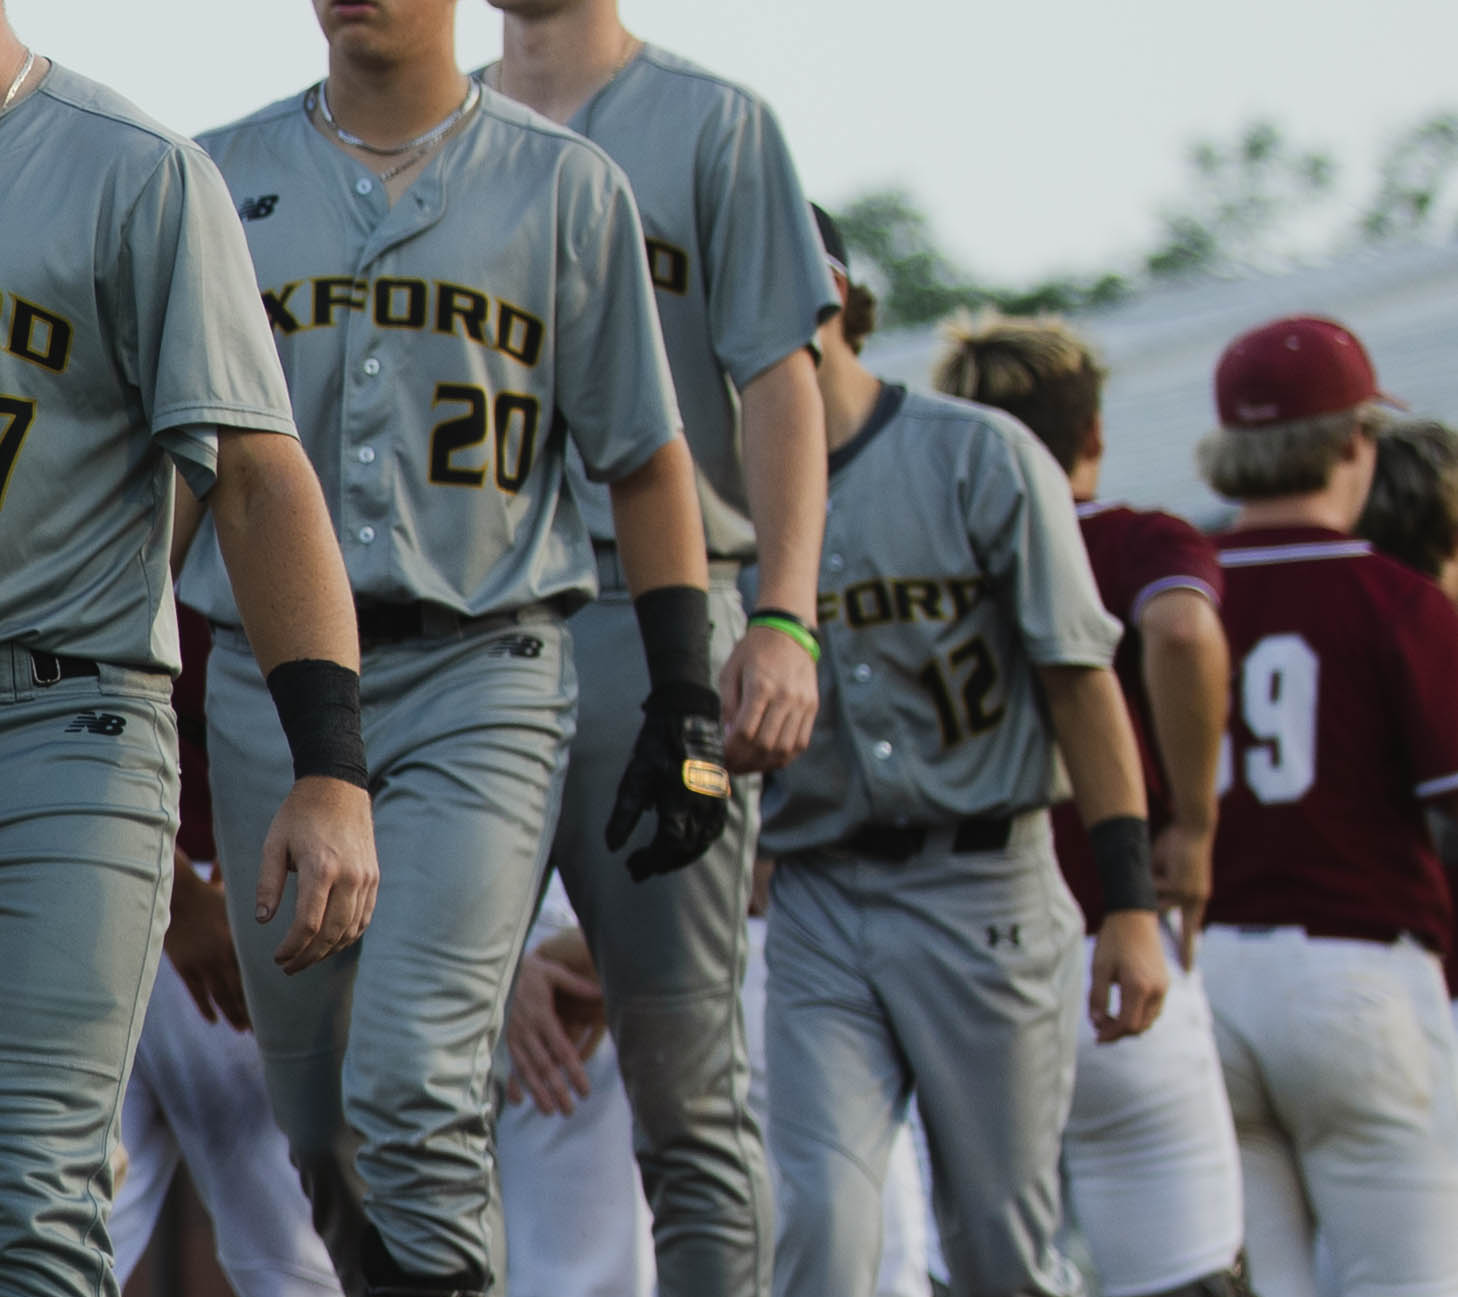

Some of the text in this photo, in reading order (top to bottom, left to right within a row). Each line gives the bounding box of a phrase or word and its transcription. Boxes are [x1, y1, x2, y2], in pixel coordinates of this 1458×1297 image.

[261, 275, 546, 369] XFORD
[427, 381, 541, 495] 20
[922, 635, 1010, 750] 12
[1216, 631, 1321, 805] 9
